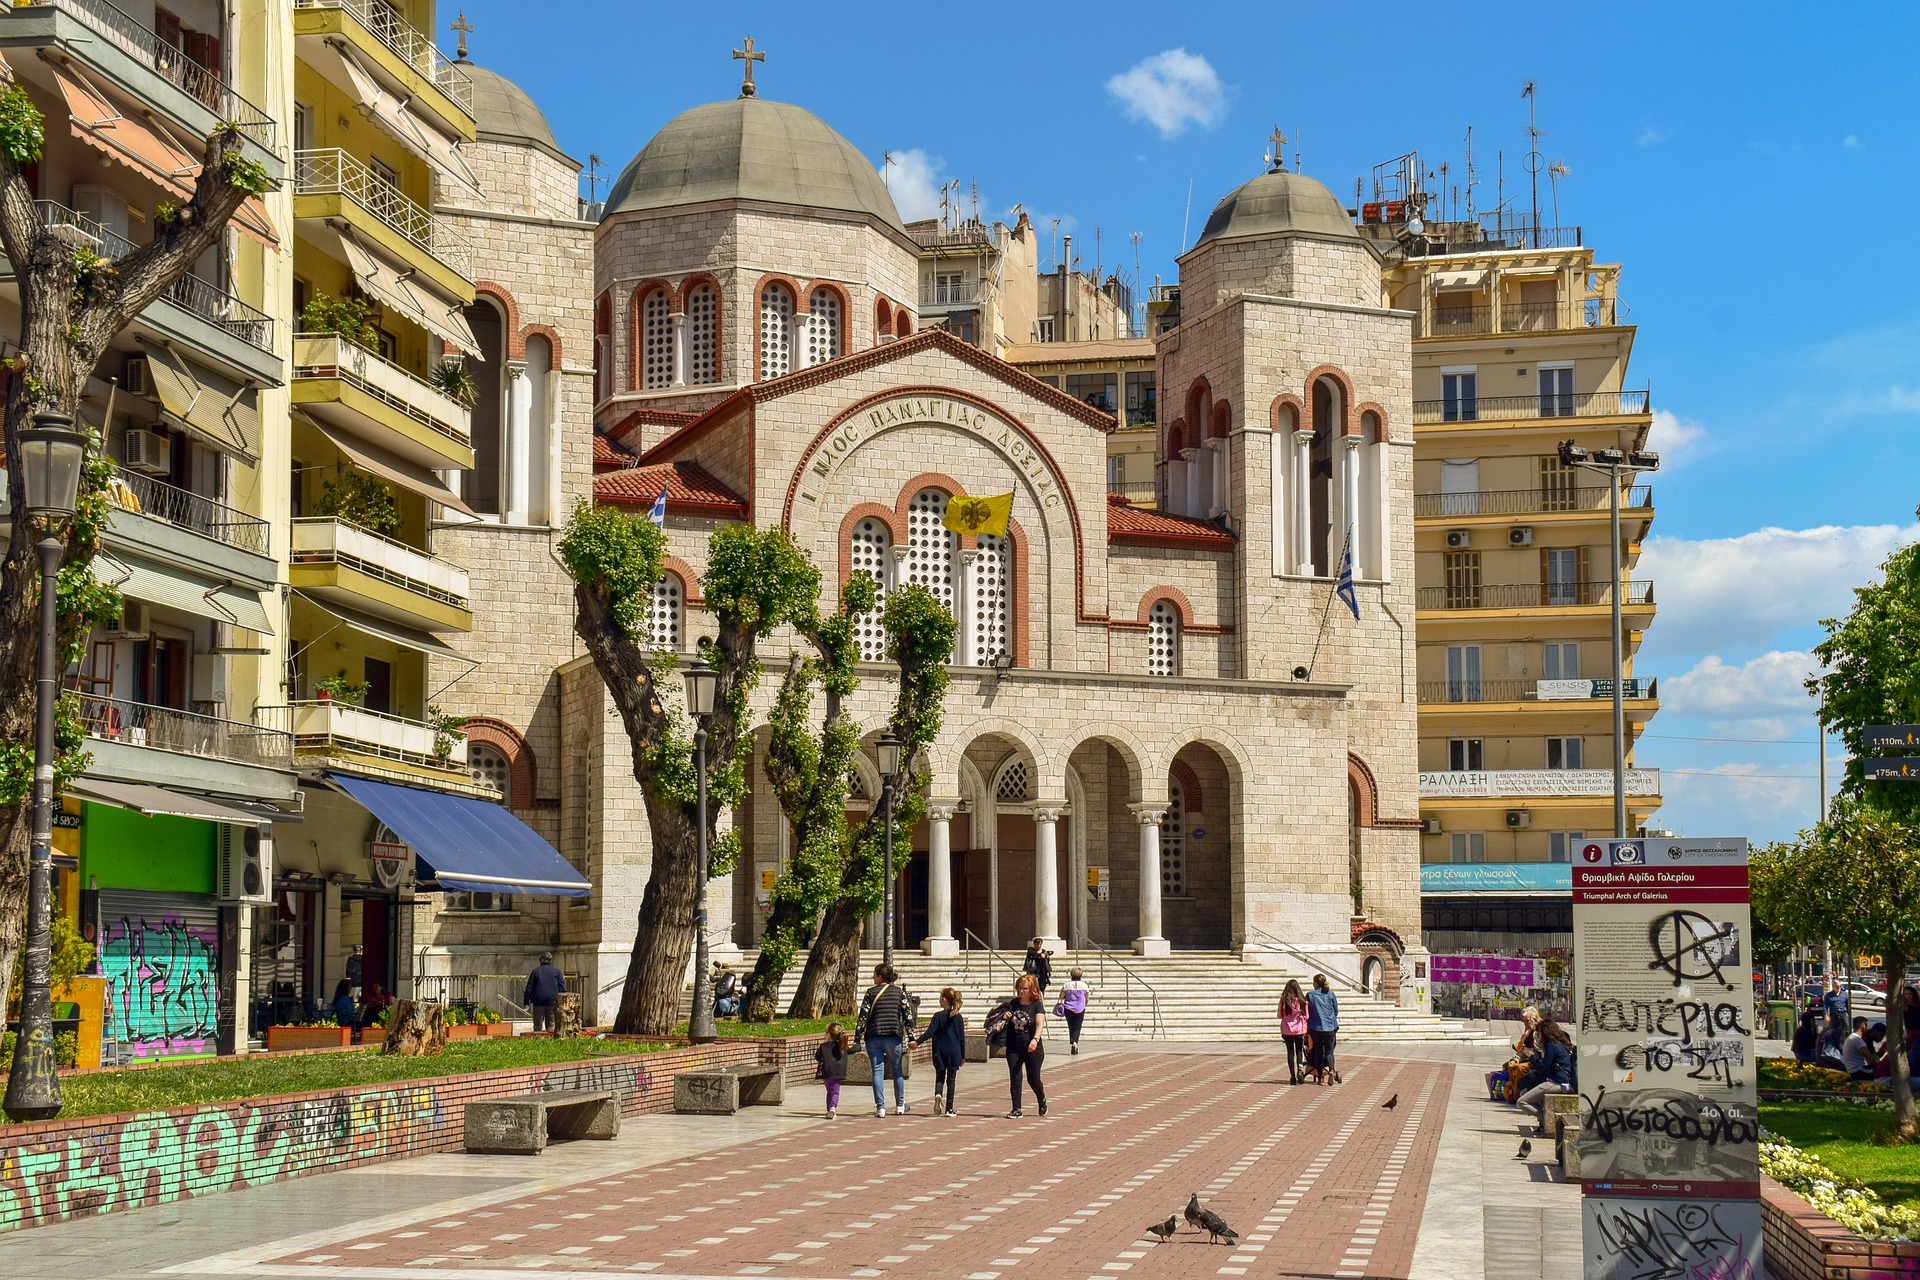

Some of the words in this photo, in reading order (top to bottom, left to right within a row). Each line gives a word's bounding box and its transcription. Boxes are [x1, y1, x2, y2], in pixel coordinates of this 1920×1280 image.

[1419, 774, 1488, 785] ΡΑΛΛΑΞΗ
[60, 815, 80, 826] SHOP
[1420, 870, 1441, 880] ντρα
[1443, 868, 1471, 879] ξένων
[1582, 872, 1625, 884] Θριαμβική
[1628, 872, 1655, 884] Αψίδα
[1657, 872, 1695, 884] Γαλερίου
[1583, 892, 1614, 901] Triumphal
